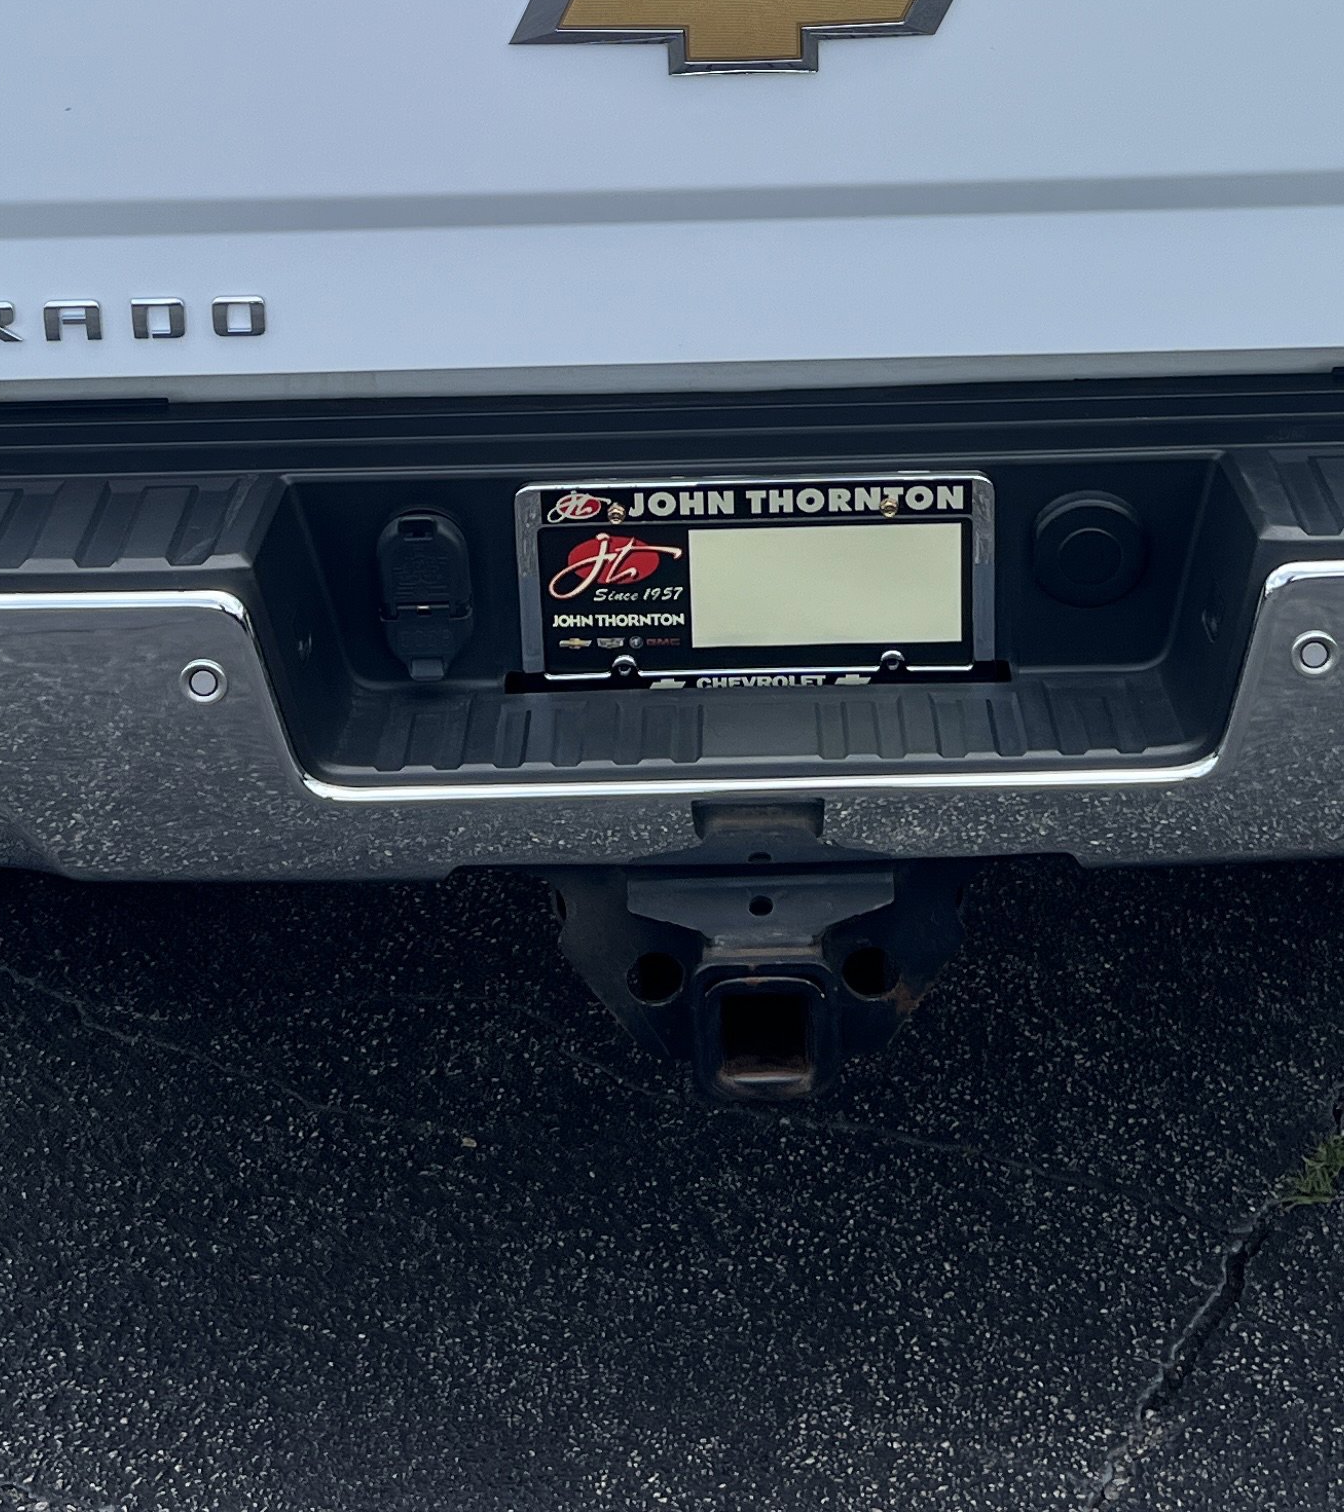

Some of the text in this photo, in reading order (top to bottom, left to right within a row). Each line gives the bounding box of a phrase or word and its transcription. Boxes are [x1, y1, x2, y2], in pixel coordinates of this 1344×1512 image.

[629, 485, 964, 517] JOHN THORNTON
[593, 587, 683, 602] Since 1957
[552, 613, 685, 628] JOHN THORNTON
[646, 638, 680, 646] GMC
[696, 675, 826, 689] CHEVROLET
